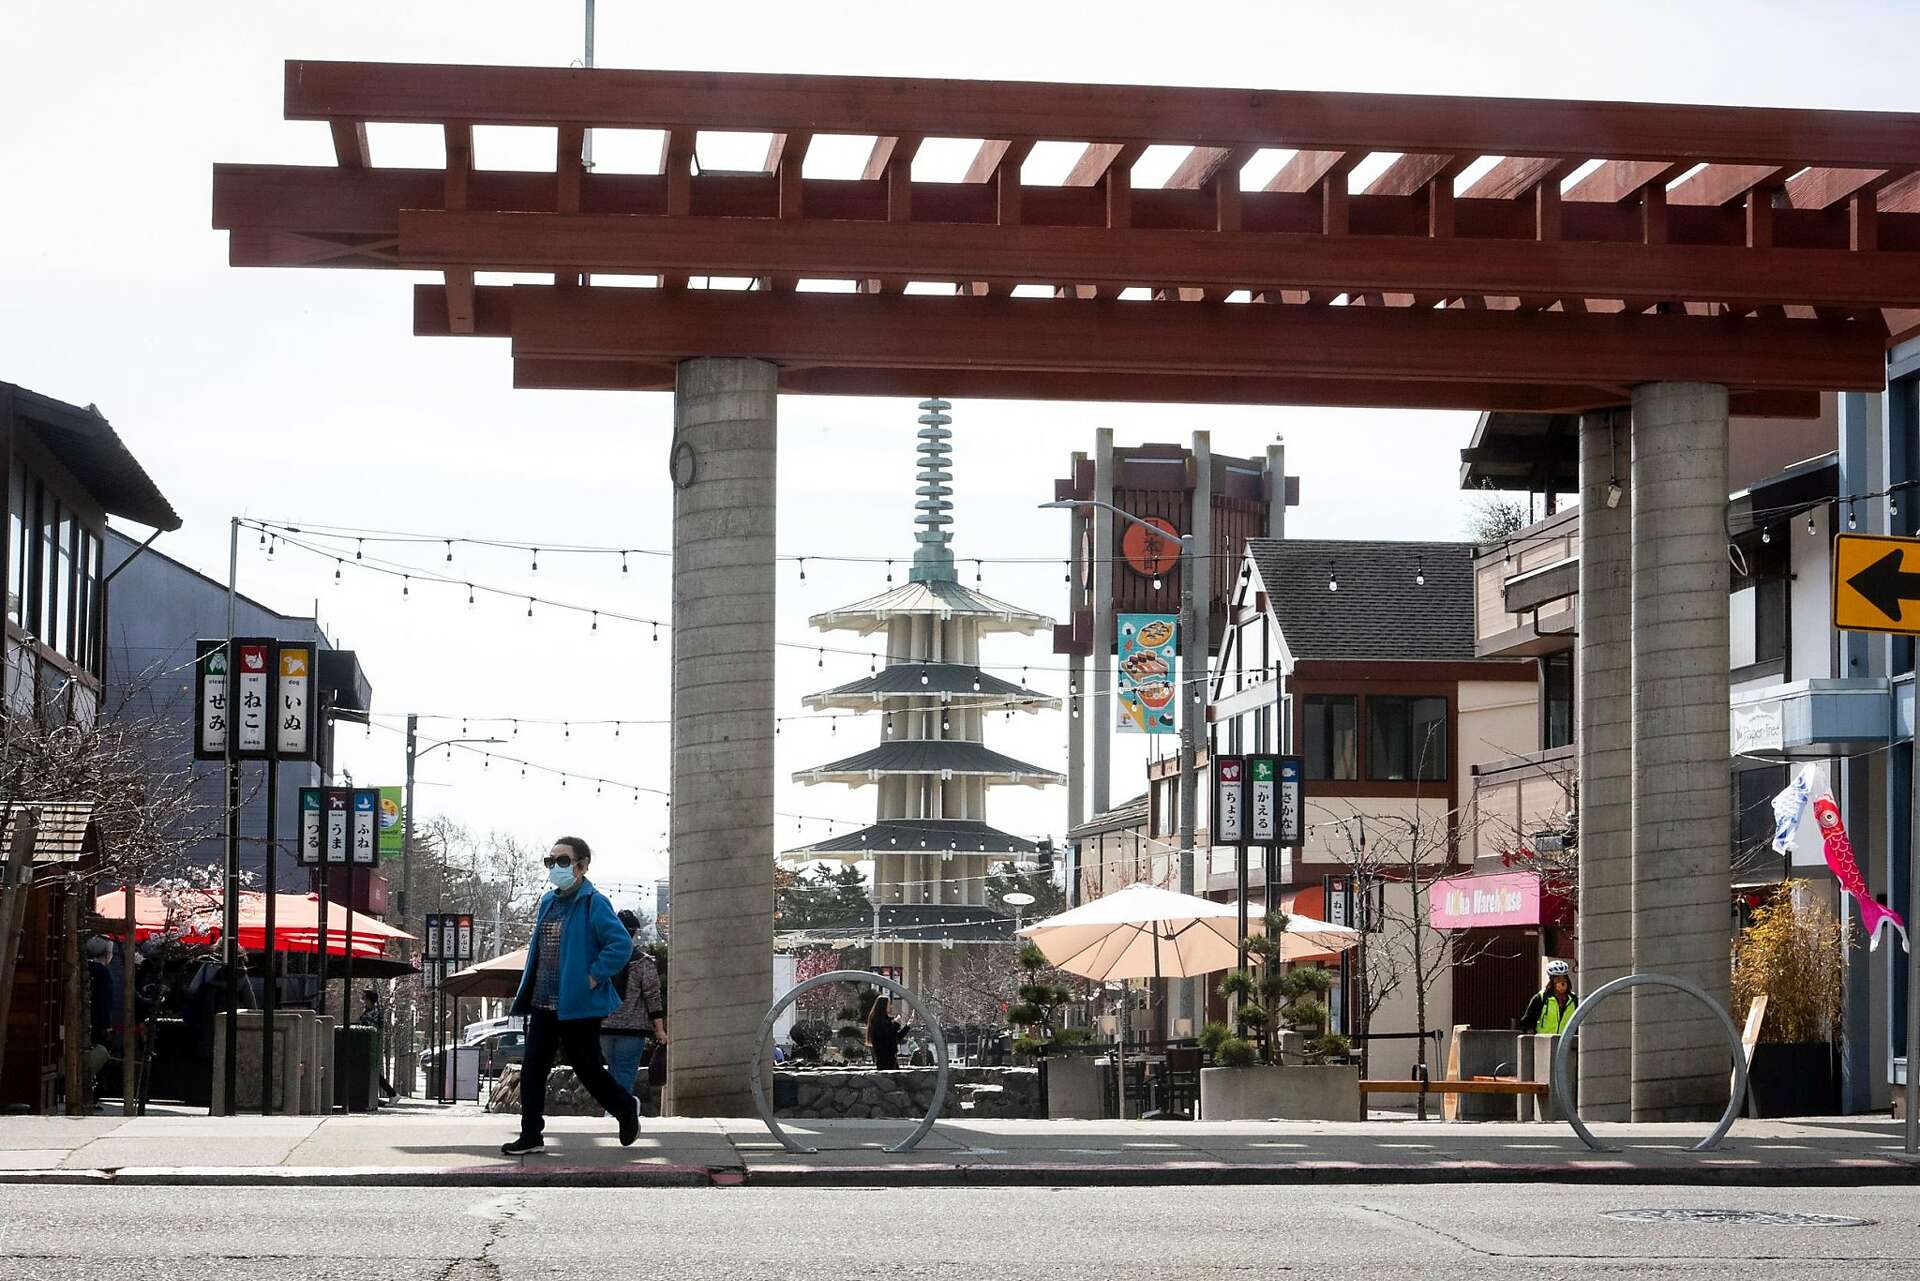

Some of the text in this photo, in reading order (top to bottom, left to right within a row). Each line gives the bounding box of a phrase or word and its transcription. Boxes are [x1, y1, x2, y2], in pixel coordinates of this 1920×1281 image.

[209, 694, 226, 731] せみ
[244, 691, 262, 728] ねこ
[284, 695, 302, 730] いぬ
[1226, 792, 1236, 827] ちょう
[1257, 792, 1269, 828] かえる
[1281, 793, 1293, 829] さかな
[307, 824, 320, 848] つる
[332, 823, 342, 849] うま
[357, 823, 370, 849] ふね
[1333, 900, 1342, 919] ねこ
